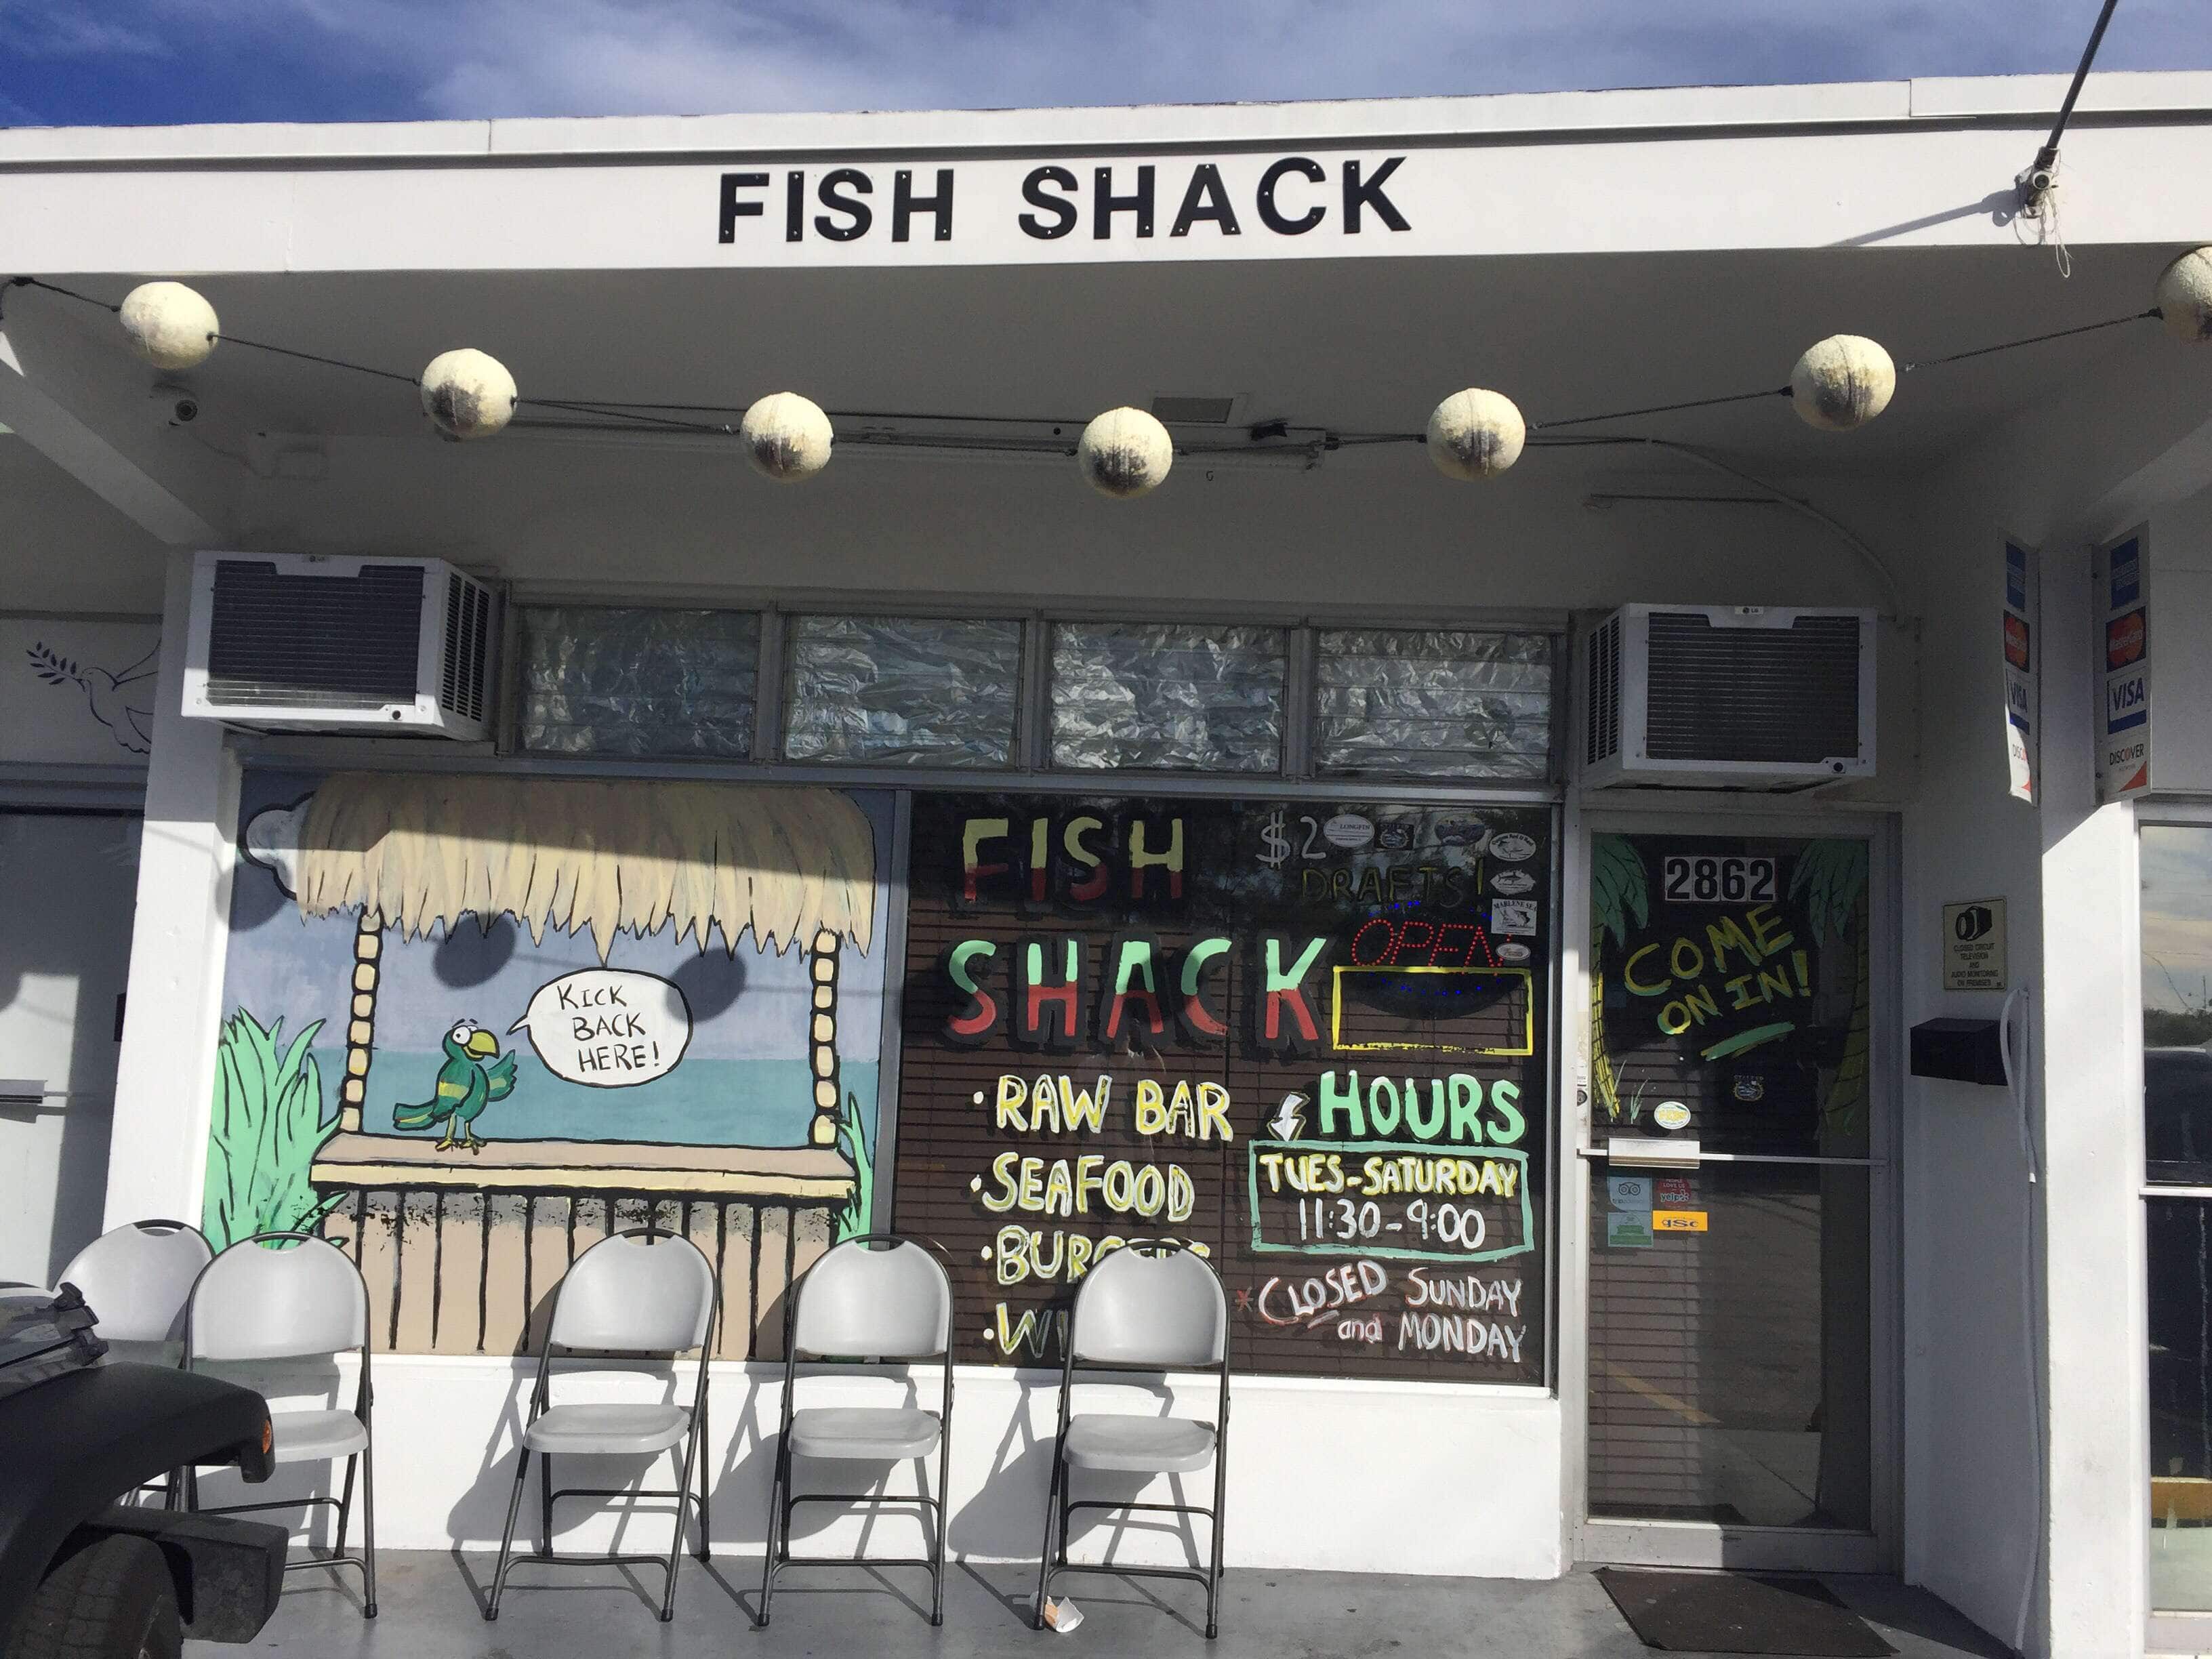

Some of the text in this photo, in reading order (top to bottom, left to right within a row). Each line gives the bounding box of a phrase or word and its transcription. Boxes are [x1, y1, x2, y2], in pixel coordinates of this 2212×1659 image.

[718, 157, 1412, 243] FISH SHACK
[2011, 681, 2028, 713] VISA
[2112, 677, 2145, 711] VISA
[2109, 743, 2145, 766] DISCOVER
[963, 817, 1183, 902] FISH
[1302, 857, 1484, 912] DRAFTS!
[1666, 858, 1774, 901] 2862
[1493, 900, 1525, 909] MARLENE
[1351, 919, 1512, 975] OPEN
[1624, 903, 1795, 996] COME
[557, 984, 627, 1010] KICK
[949, 938, 1326, 1040] SHACK
[1657, 949, 1811, 1035] ON IN!
[573, 1012, 646, 1041] BACK
[577, 1041, 659, 1072] HERE!
[996, 1075, 1233, 1141] RAW BAR
[1319, 1070, 1525, 1144] HOURS
[982, 1152, 1195, 1222] SEAFOOD
[1260, 1153, 1517, 1197] TUES-SATURDAY
[1660, 1193, 1679, 1203] yelp
[1299, 1198, 1486, 1249] 11:30-9:00
[1258, 1259, 1522, 1325] CLOSED SUNDAY
[1338, 1312, 1526, 1363] and MONDAY
